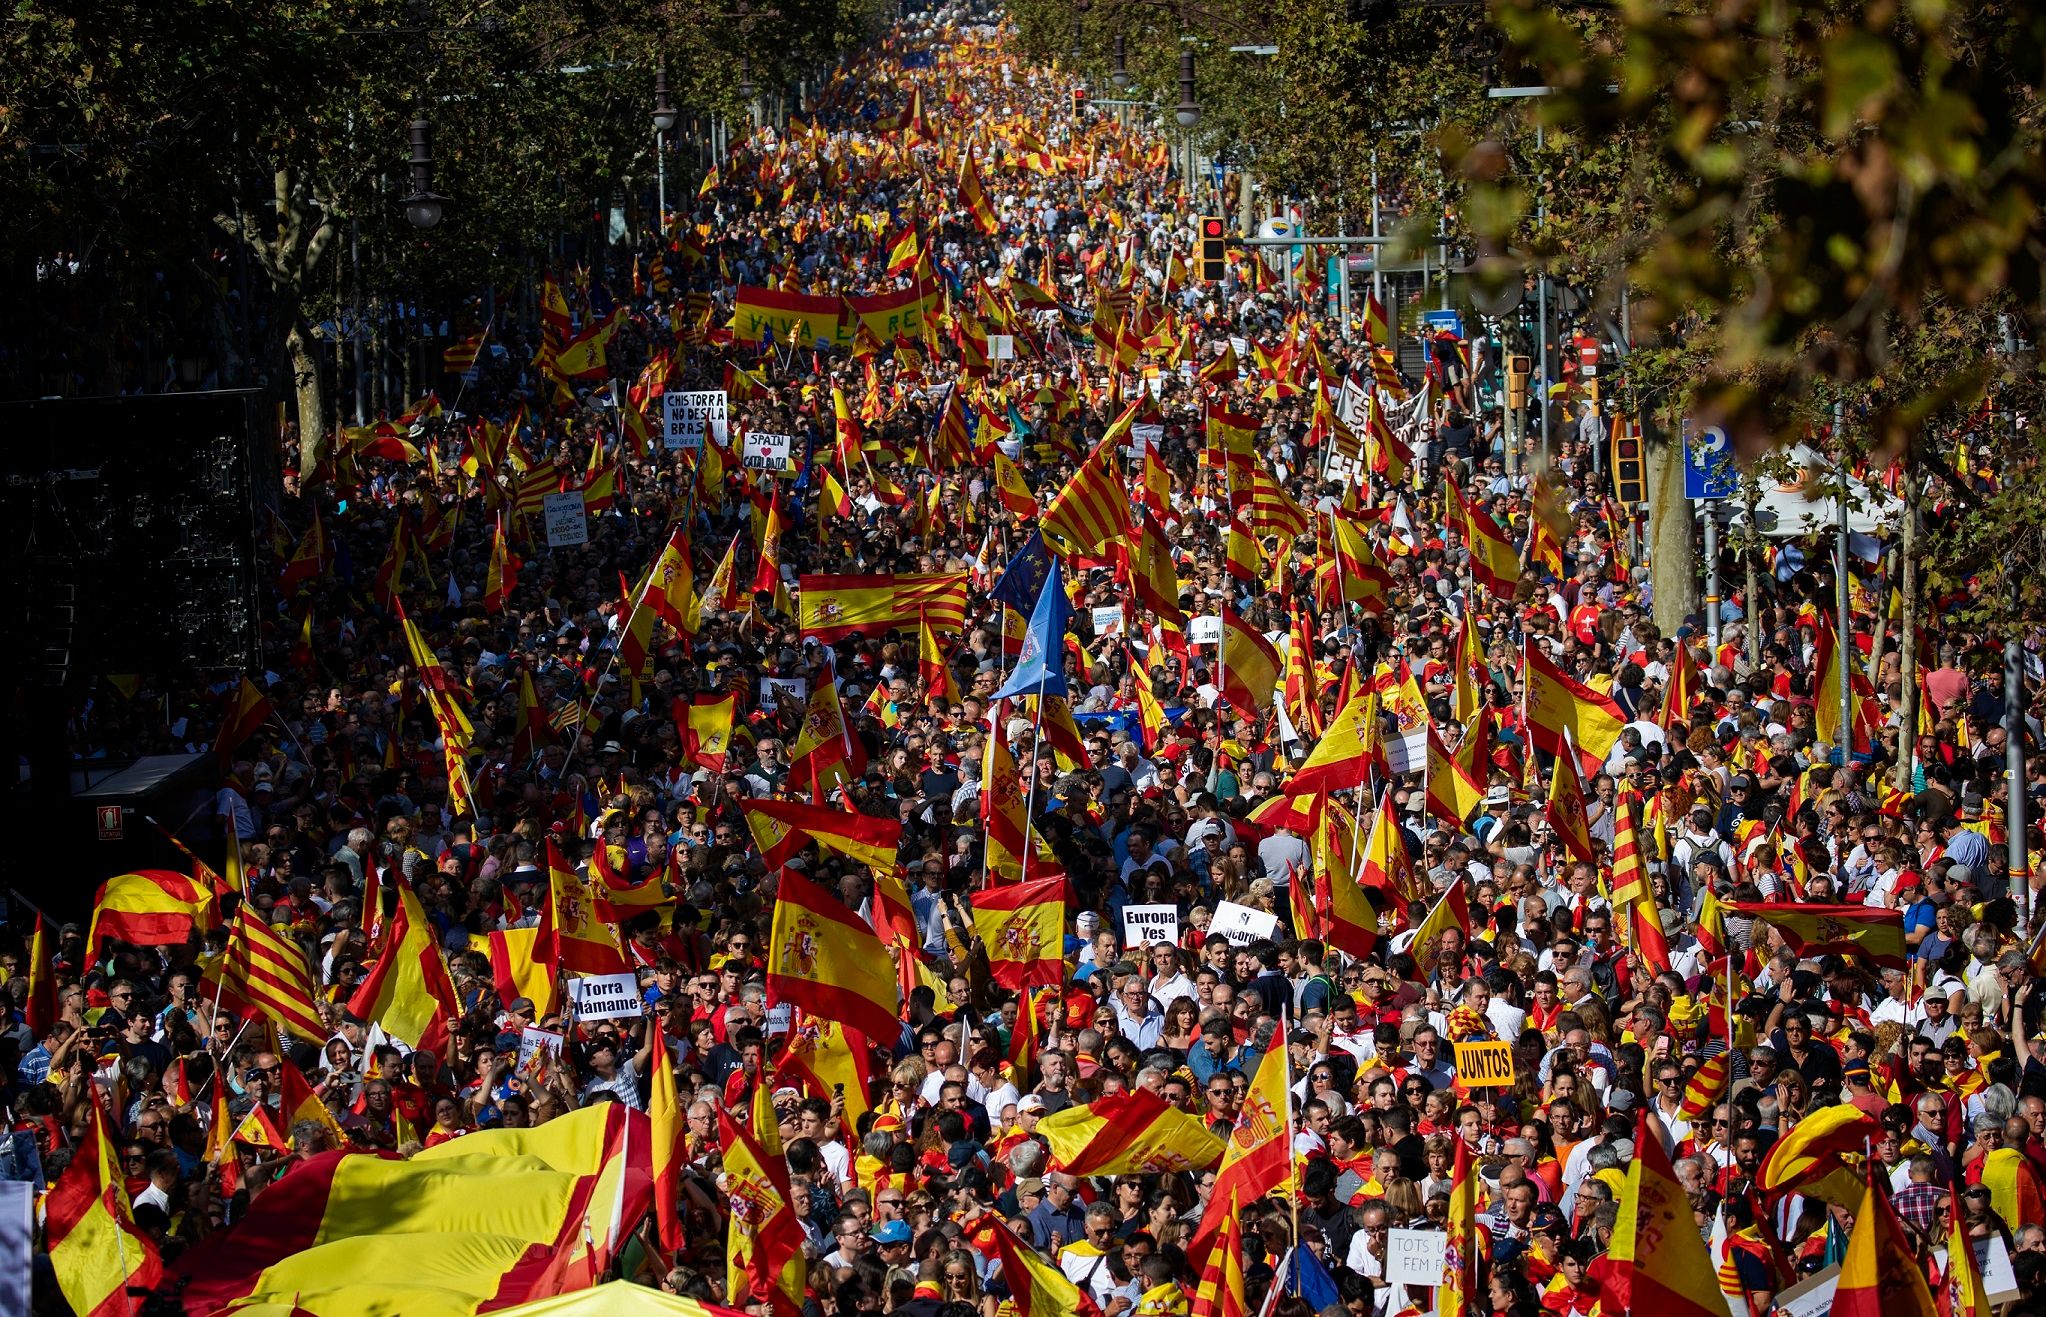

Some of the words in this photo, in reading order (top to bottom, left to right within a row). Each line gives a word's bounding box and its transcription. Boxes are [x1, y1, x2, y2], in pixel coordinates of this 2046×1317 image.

[672, 408, 684, 420] NO
[749, 434, 784, 446] SPAIN
[1126, 911, 1175, 924] Europa
[1141, 927, 1166, 940] Yes
[583, 982, 623, 996] Torra
[575, 998, 638, 1014] llámame
[523, 1036, 534, 1046] Las
[1461, 1048, 1510, 1079] JUNTOS
[1394, 1238, 1429, 1253] TOTS
[1404, 1257, 1429, 1271] FEM
